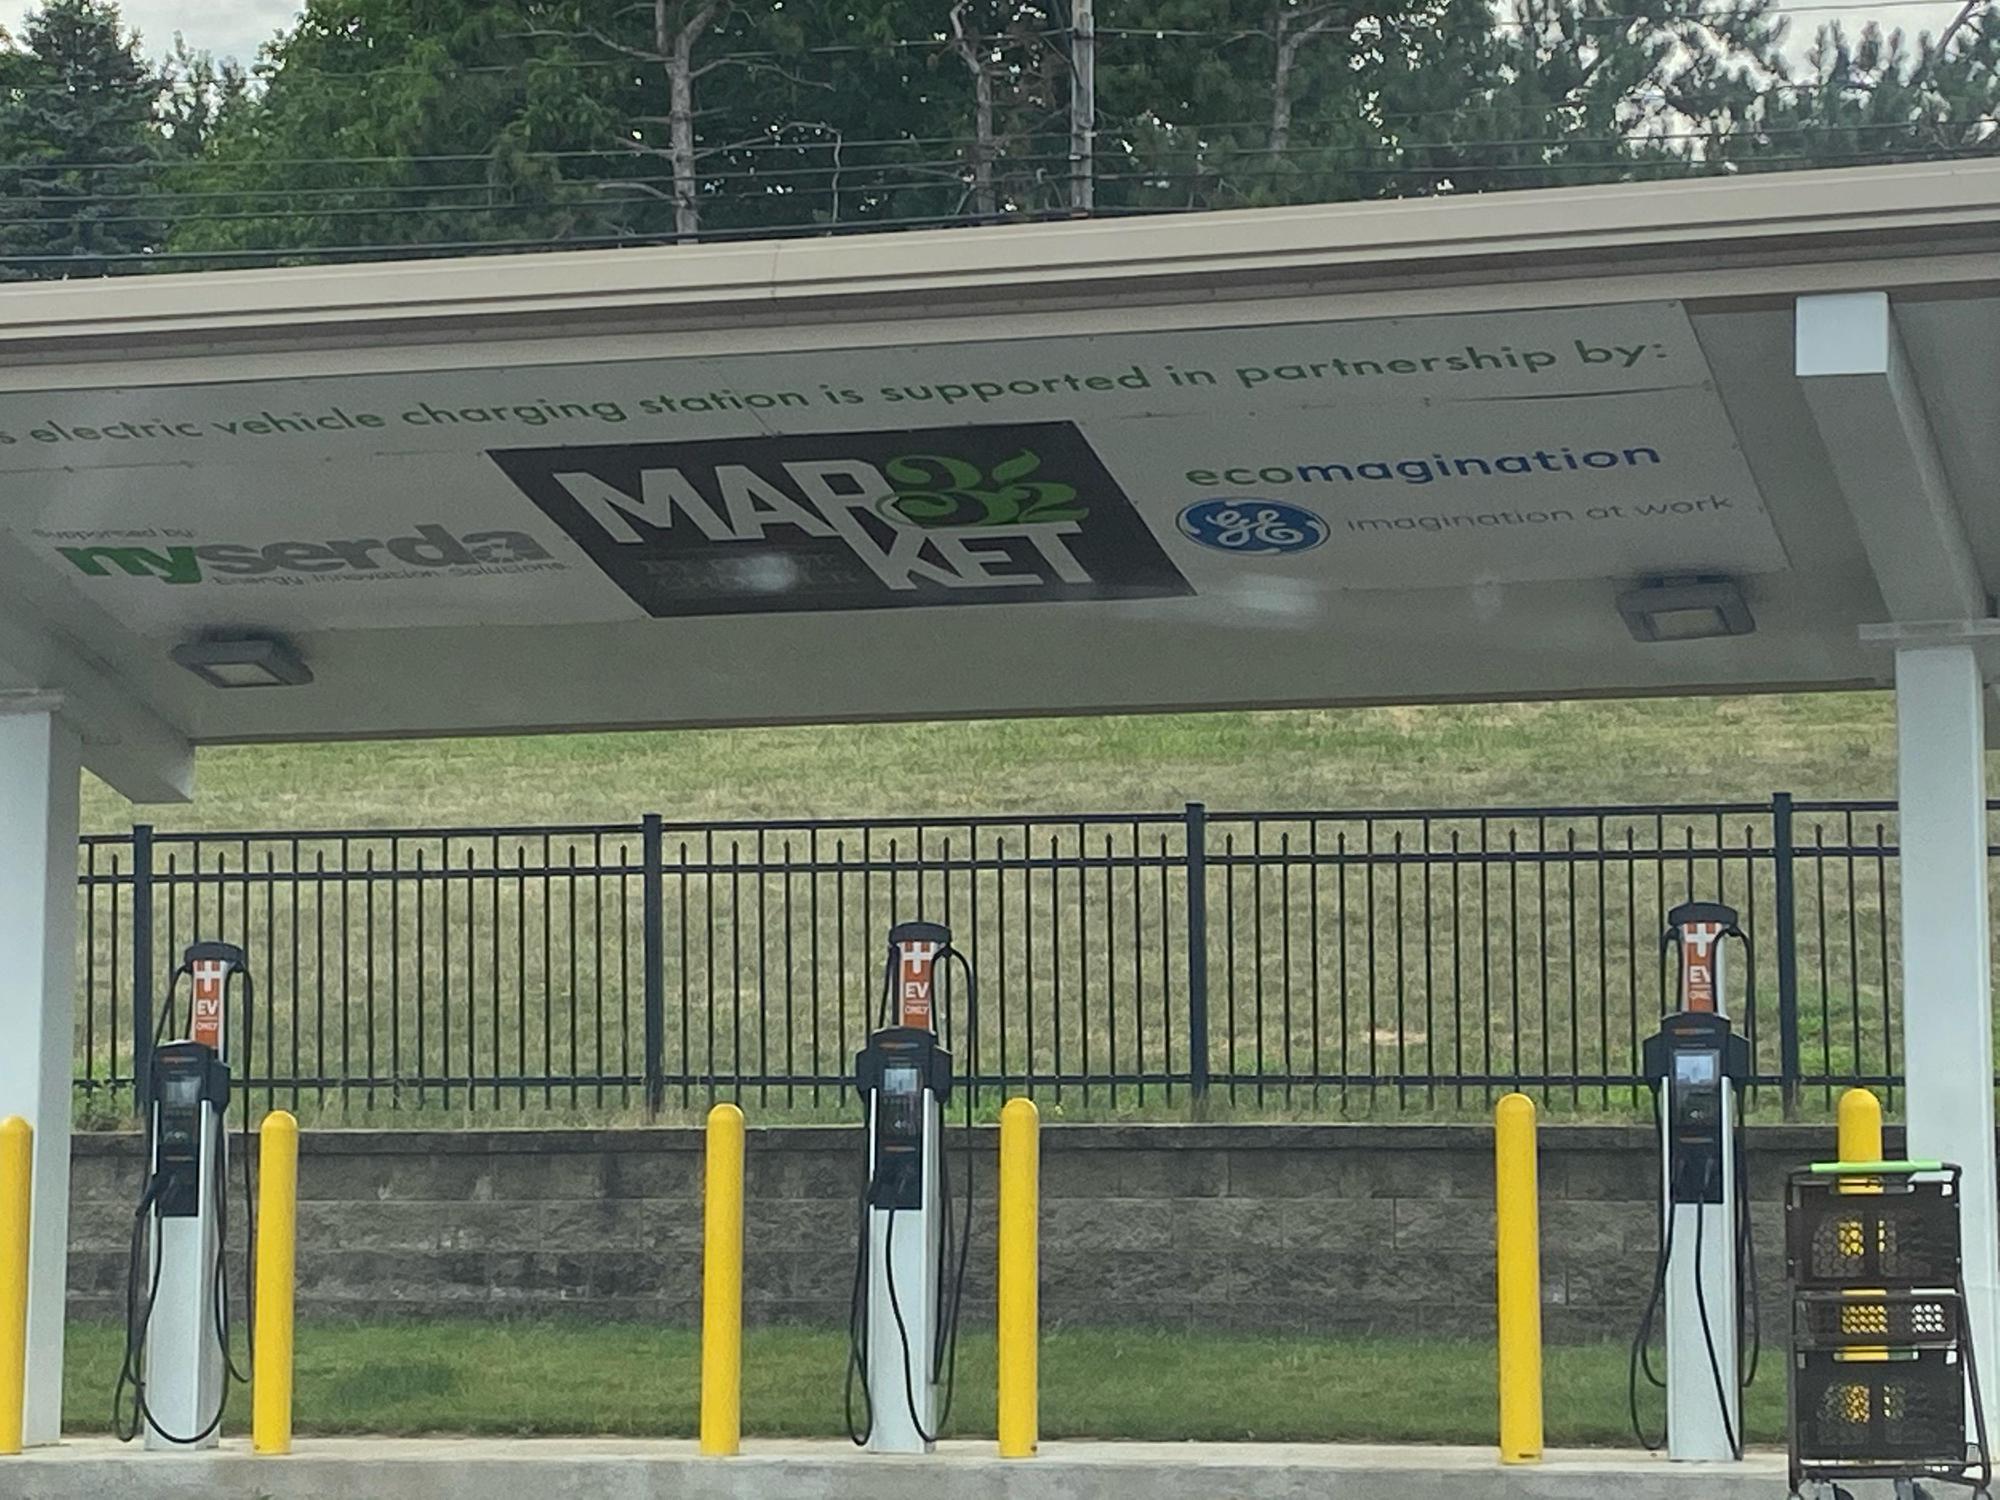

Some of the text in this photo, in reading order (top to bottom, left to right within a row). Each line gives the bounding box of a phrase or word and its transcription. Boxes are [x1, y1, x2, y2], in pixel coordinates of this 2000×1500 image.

[29, 419, 205, 443] electric
[211, 408, 386, 436] vehicle
[402, 400, 627, 426] charging
[640, 390, 810, 416] station
[821, 382, 864, 405] is
[881, 368, 1152, 404] supported
[1166, 365, 1217, 388] in
[1236, 345, 1558, 388] partnership
[1574, 339, 1668, 369] by:
[1186, 444, 1661, 485] ecomagination
[1347, 495, 1732, 533] imagination at work
[197, 1000, 218, 1015] EV
[905, 981, 930, 998] EV
